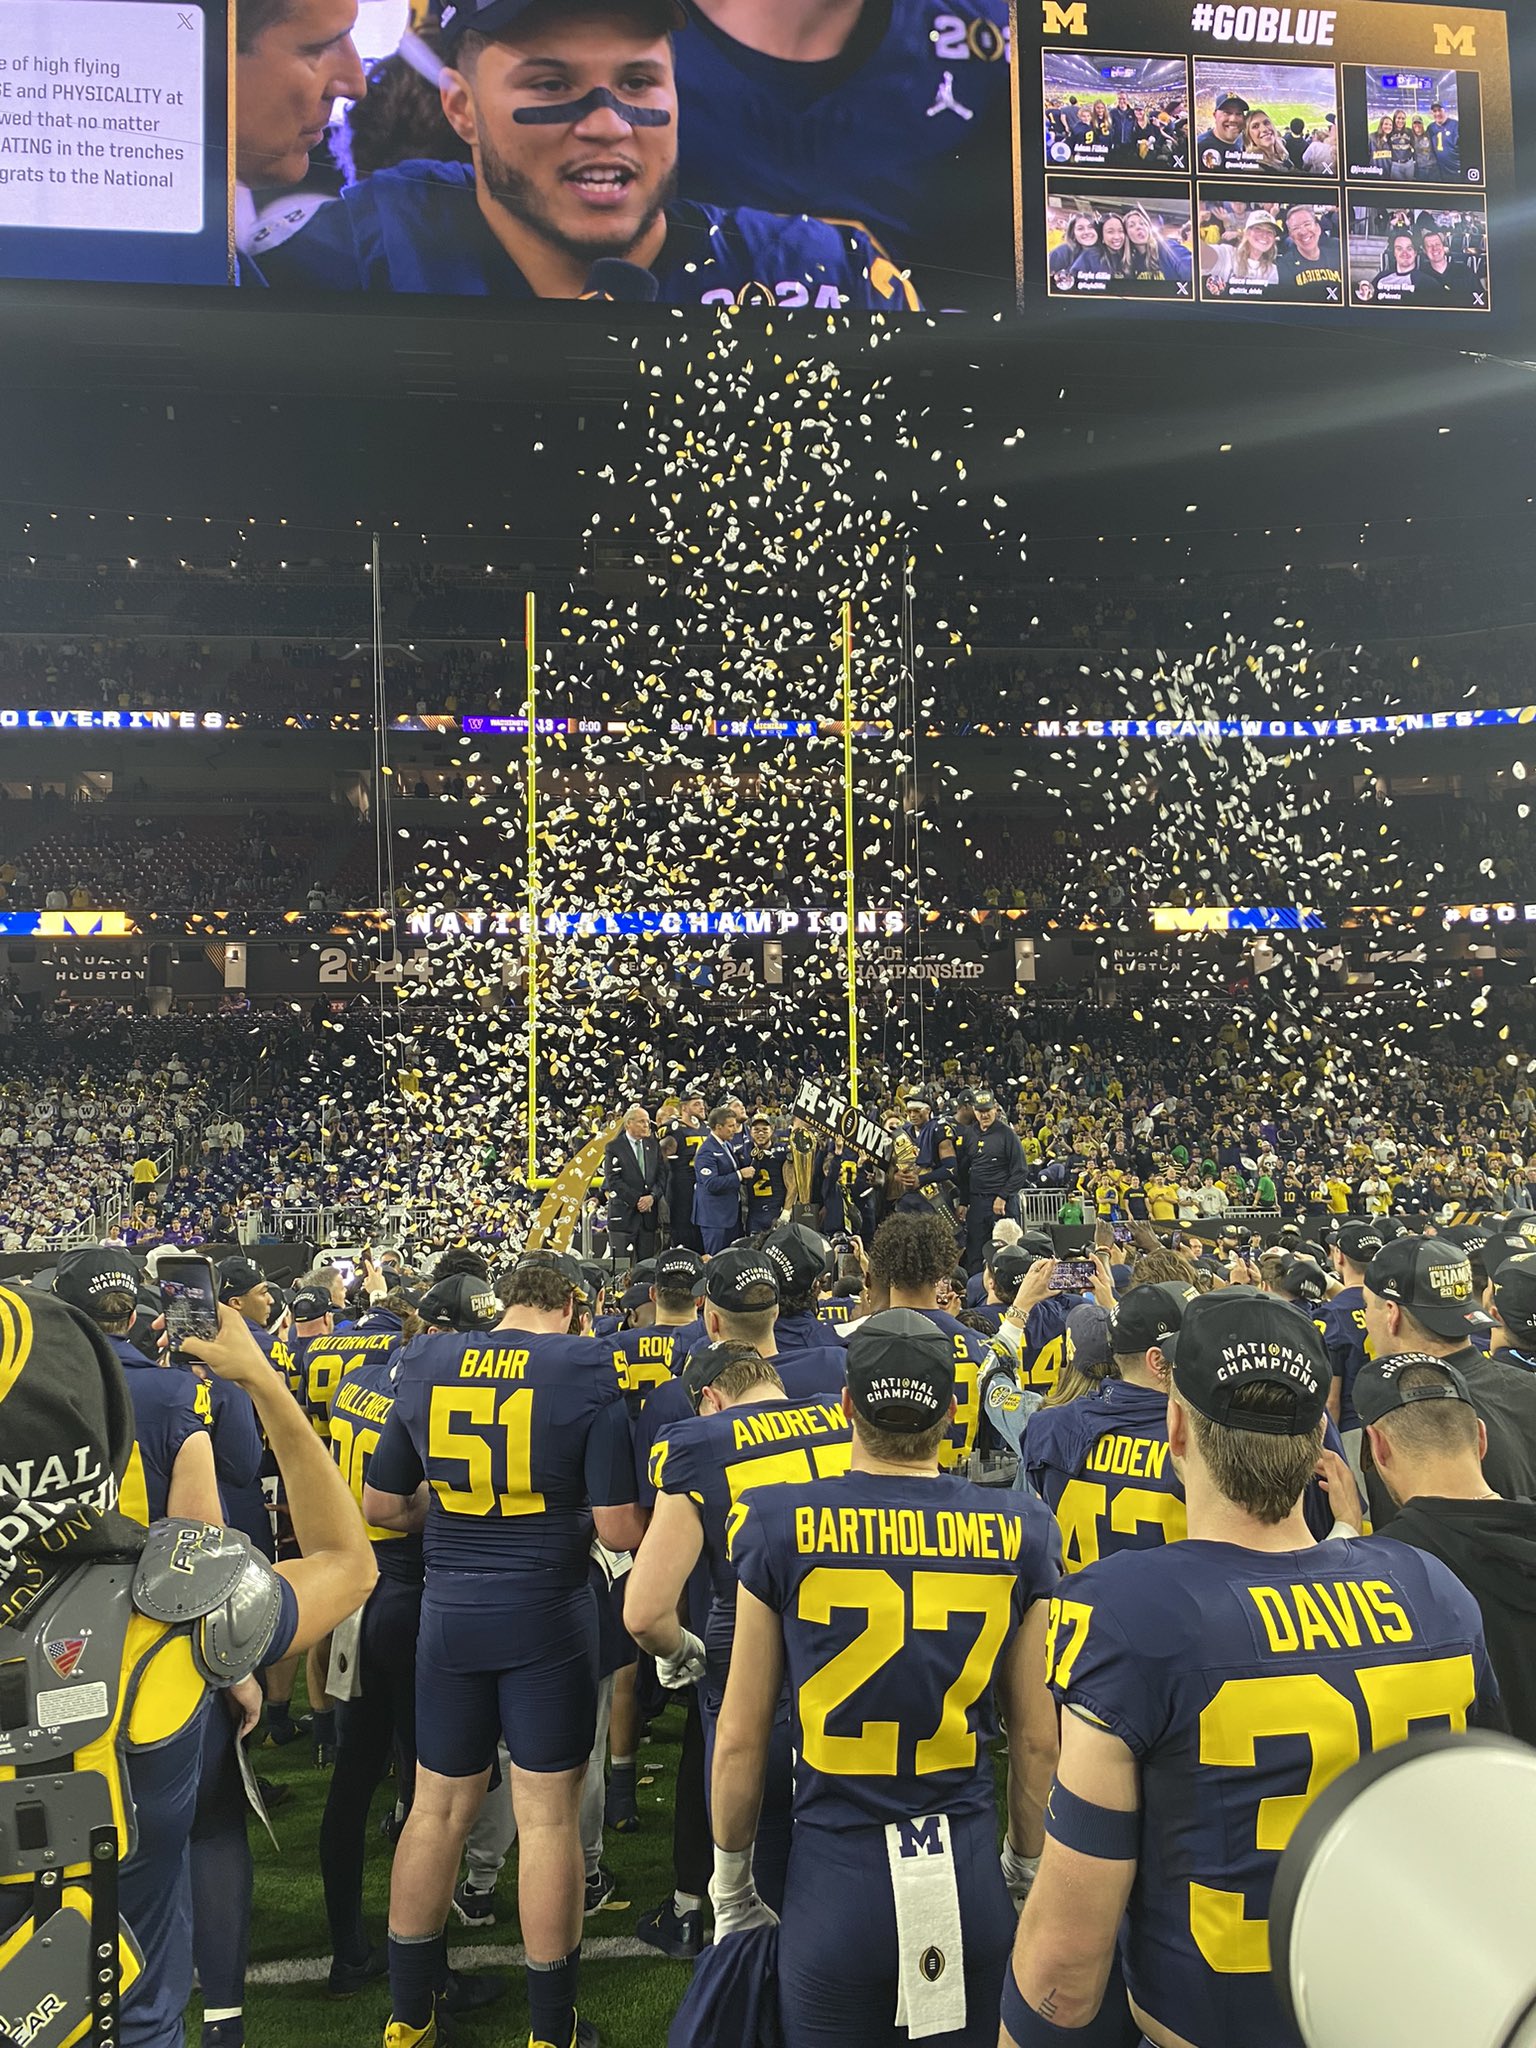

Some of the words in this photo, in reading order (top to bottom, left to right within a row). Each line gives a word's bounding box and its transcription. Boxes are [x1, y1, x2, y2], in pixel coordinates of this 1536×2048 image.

[1042, 1, 1088, 35] M
[1192, 3, 1336, 46] #GOBLUE
[1433, 23, 1476, 56] M
[12, 56, 29, 71] of
[34, 57, 69, 76] high
[74, 58, 120, 78] flying
[17, 84, 47, 99] and
[52, 84, 162, 105] PHYSICALITY
[166, 91, 183, 105] at
[38, 112, 72, 127] that
[78, 116, 97, 129] no
[103, 116, 160, 131] matter
[57, 140, 71, 155] in
[77, 141, 104, 156] the
[110, 143, 184, 160] trenches
[49, 168, 66, 183] to
[71, 168, 98, 184] the
[104, 169, 173, 187] National
[0, 711, 222, 728] OLVERINES
[579, 720, 601, 732] 0:00
[1037, 719, 1222, 737] MICHIGAN
[1240, 711, 1473, 737] WOLVERINES
[411, 911, 621, 934] NATIONAL
[661, 911, 905, 934] CHAMPIONS
[1461, 1145, 1473, 1157] 10
[753, 1169, 773, 1197] 2
[1284, 1191, 1296, 1202] 10
[88, 1280, 138, 1295] CHAMPIONS
[91, 1271, 135, 1286] NATIONAL
[459, 1348, 530, 1379] BAHR
[1222, 1342, 1313, 1374] NATIONAL
[871, 1377, 934, 1395] NATIONAL
[1216, 1355, 1319, 1394] CHAMPIONS
[867, 1387, 938, 1409] CHAMPIONS
[429, 1386, 546, 1518] 51
[795, 1506, 1022, 1561] BARTHOLOMEW
[1248, 1580, 1413, 1652] DAVIS
[797, 1567, 1018, 1776] 27
[898, 1816, 945, 1858] M
